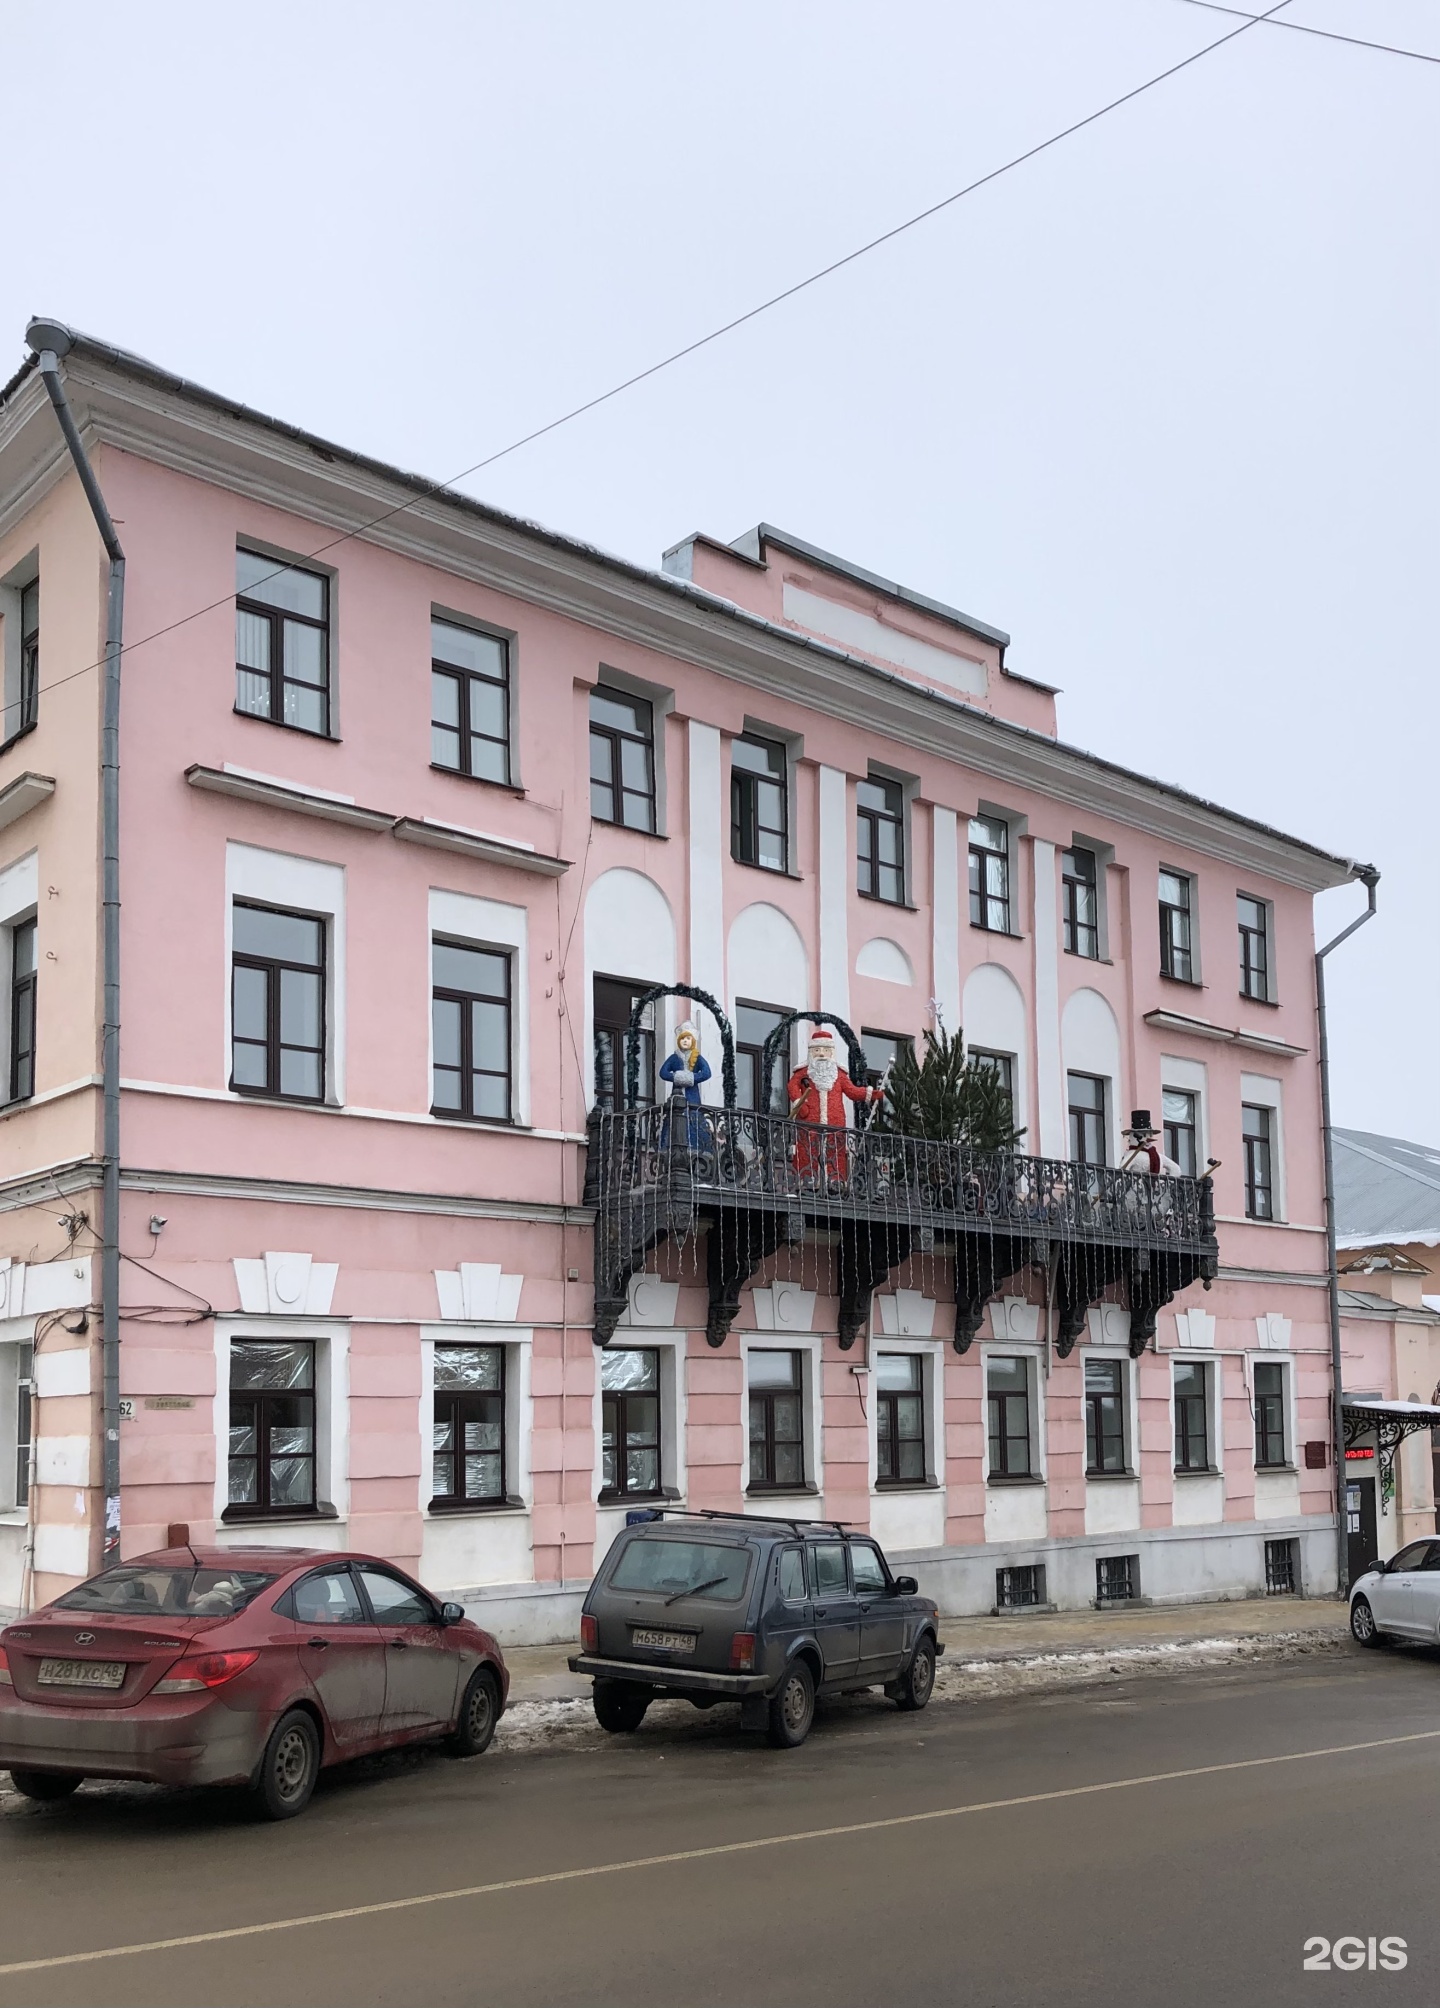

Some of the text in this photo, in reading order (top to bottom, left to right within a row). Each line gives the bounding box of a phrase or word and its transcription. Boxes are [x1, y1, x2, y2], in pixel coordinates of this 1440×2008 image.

[119, 1402, 132, 1415] 62
[681, 1635, 692, 1645] 48
[104, 1664, 119, 1678] 48
